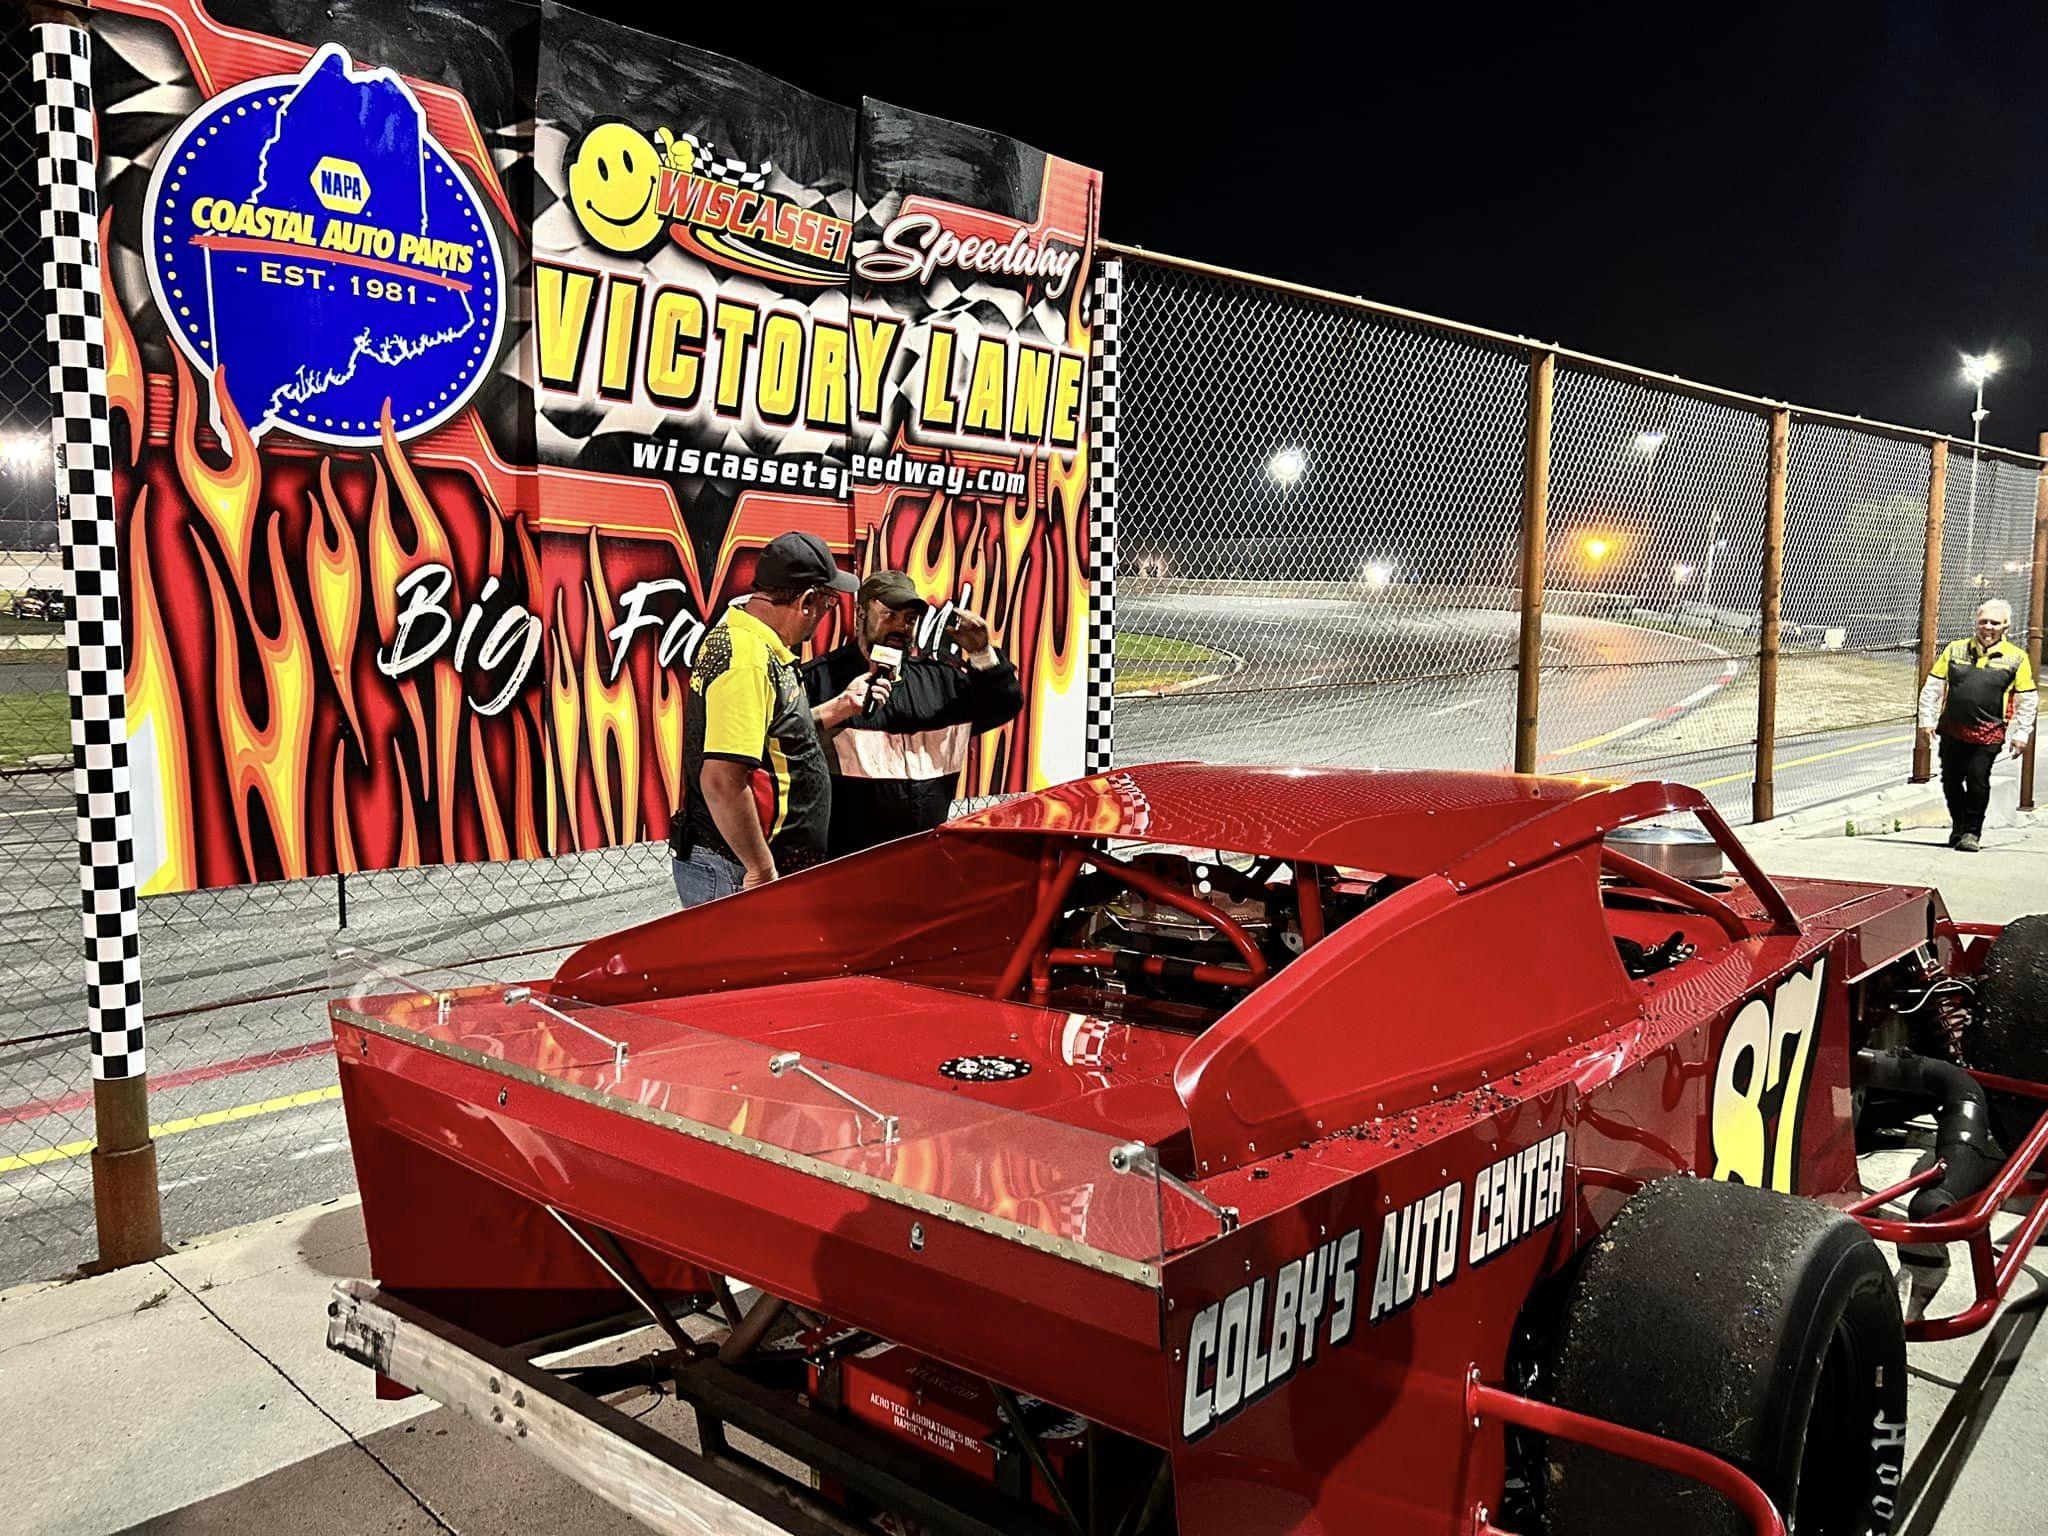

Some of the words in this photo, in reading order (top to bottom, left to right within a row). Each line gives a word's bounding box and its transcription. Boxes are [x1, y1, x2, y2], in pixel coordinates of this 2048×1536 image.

[320, 171, 362, 201] NAPA
[654, 165, 852, 265] WISCASSET
[190, 197, 317, 246] COASTAL
[325, 218, 395, 257] AUTO
[398, 232, 474, 275] PARTS
[856, 213, 1080, 299] Speedway
[261, 262, 336, 292] EST.
[350, 276, 417, 306] 1981
[534, 264, 900, 428] VICTORY
[920, 330, 1084, 448] LANE
[377, 563, 543, 716] Big
[1712, 956, 1825, 1194] 87
[1182, 1228, 1363, 1439] COLBY'S
[1369, 1181, 1463, 1321] AUTO
[1468, 1131, 1567, 1265] CENTER
[870, 1392, 890, 1409] AERO
[939, 1437, 955, 1452] USA
